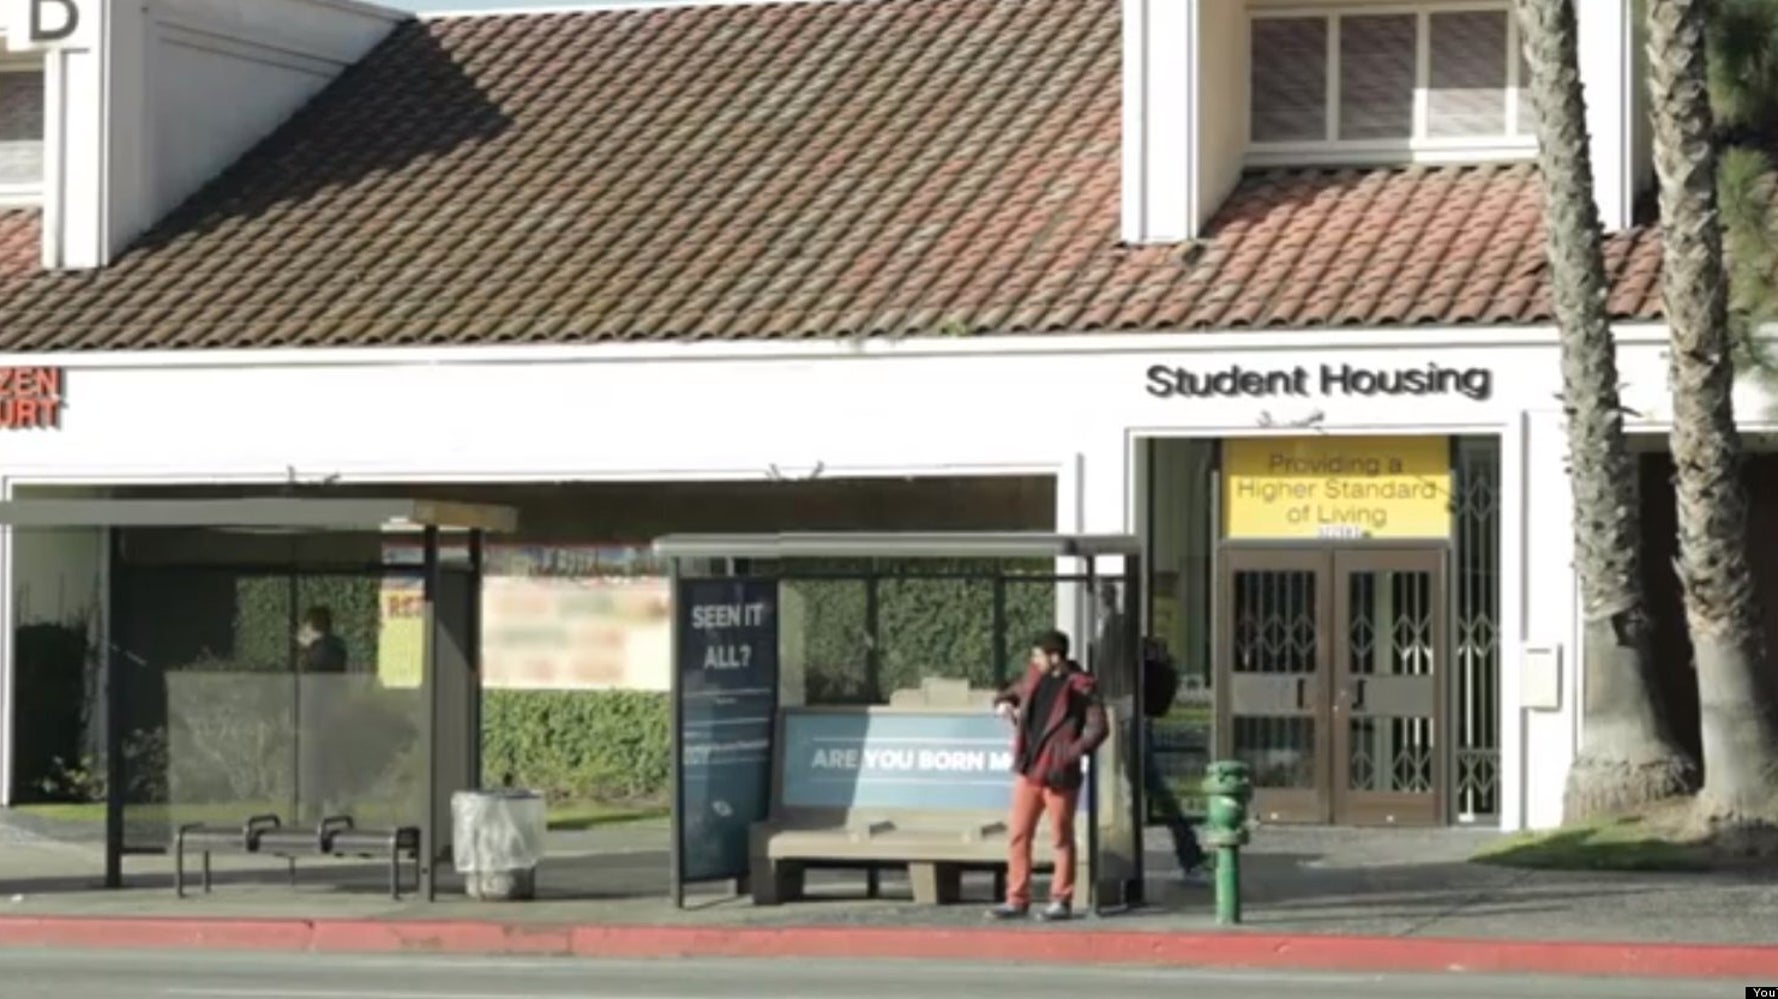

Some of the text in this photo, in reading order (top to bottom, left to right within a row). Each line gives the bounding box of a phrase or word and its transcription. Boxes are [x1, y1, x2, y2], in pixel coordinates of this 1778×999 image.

[1146, 363, 1493, 401] Student Housing
[1268, 453, 1404, 475] Providing a
[1236, 478, 1438, 502] Higher Standard
[1286, 505, 1388, 527] of Living
[692, 602, 763, 629] SEEN IT
[704, 645, 752, 669] ALL?
[811, 749, 858, 769] ARE
[863, 749, 913, 771] YOU
[918, 750, 984, 771] BORN
